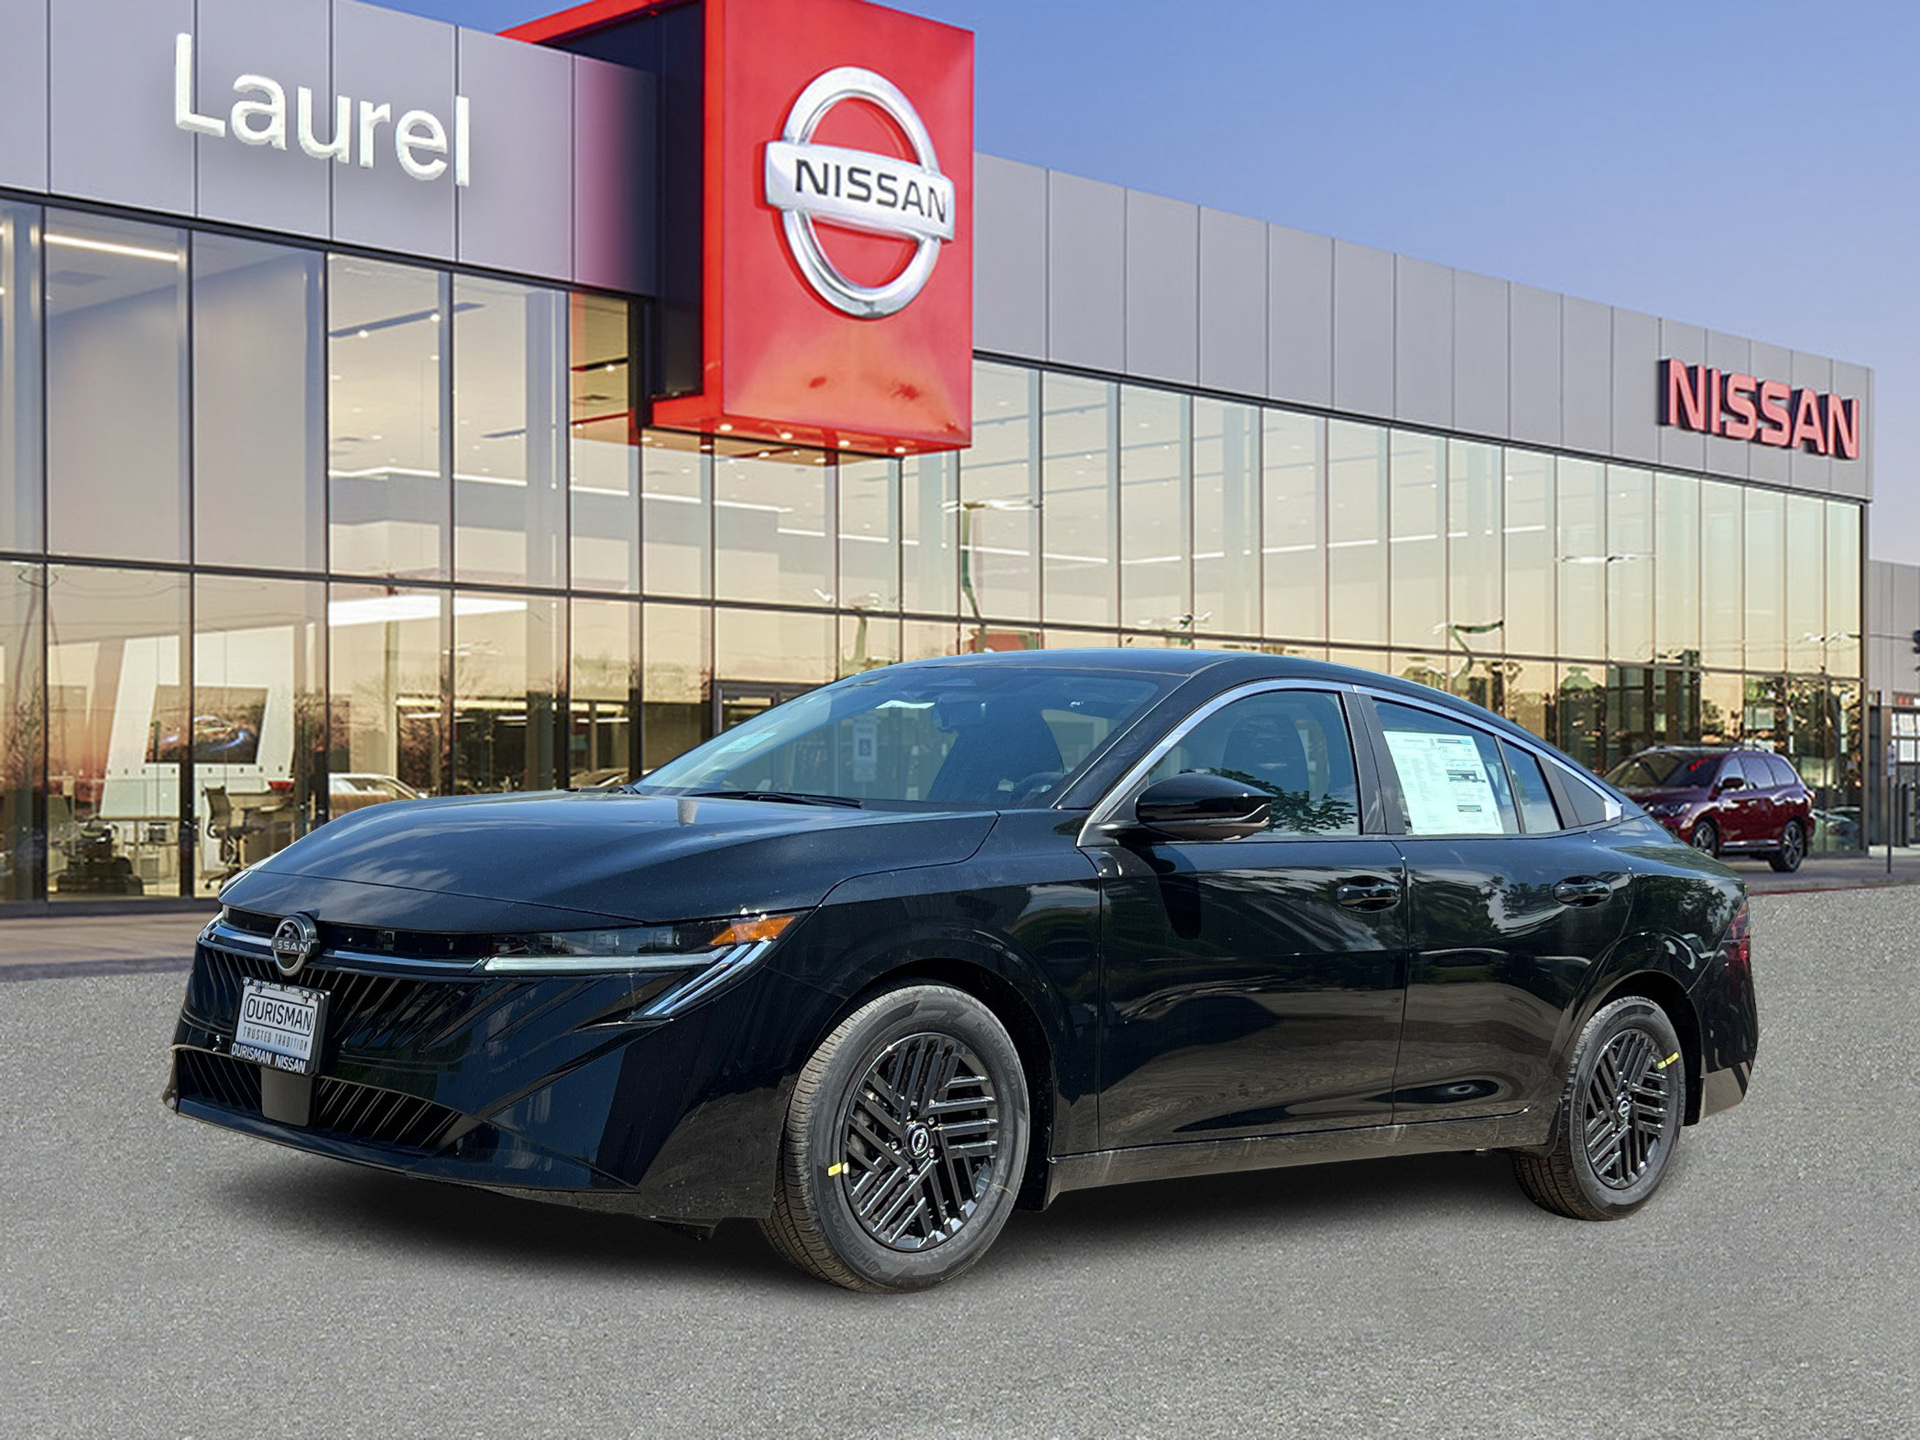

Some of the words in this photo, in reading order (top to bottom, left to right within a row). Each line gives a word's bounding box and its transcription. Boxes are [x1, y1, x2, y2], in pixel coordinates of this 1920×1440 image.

[175, 33, 470, 188] Laurel
[795, 159, 946, 224] NISSAN
[1657, 358, 1860, 460] NISSAN
[243, 1026, 271, 1043] TRUSTED
[246, 998, 312, 1031] OURISMAN
[231, 1043, 271, 1066] OURISMAN
[275, 1055, 307, 1073] NISSAN
